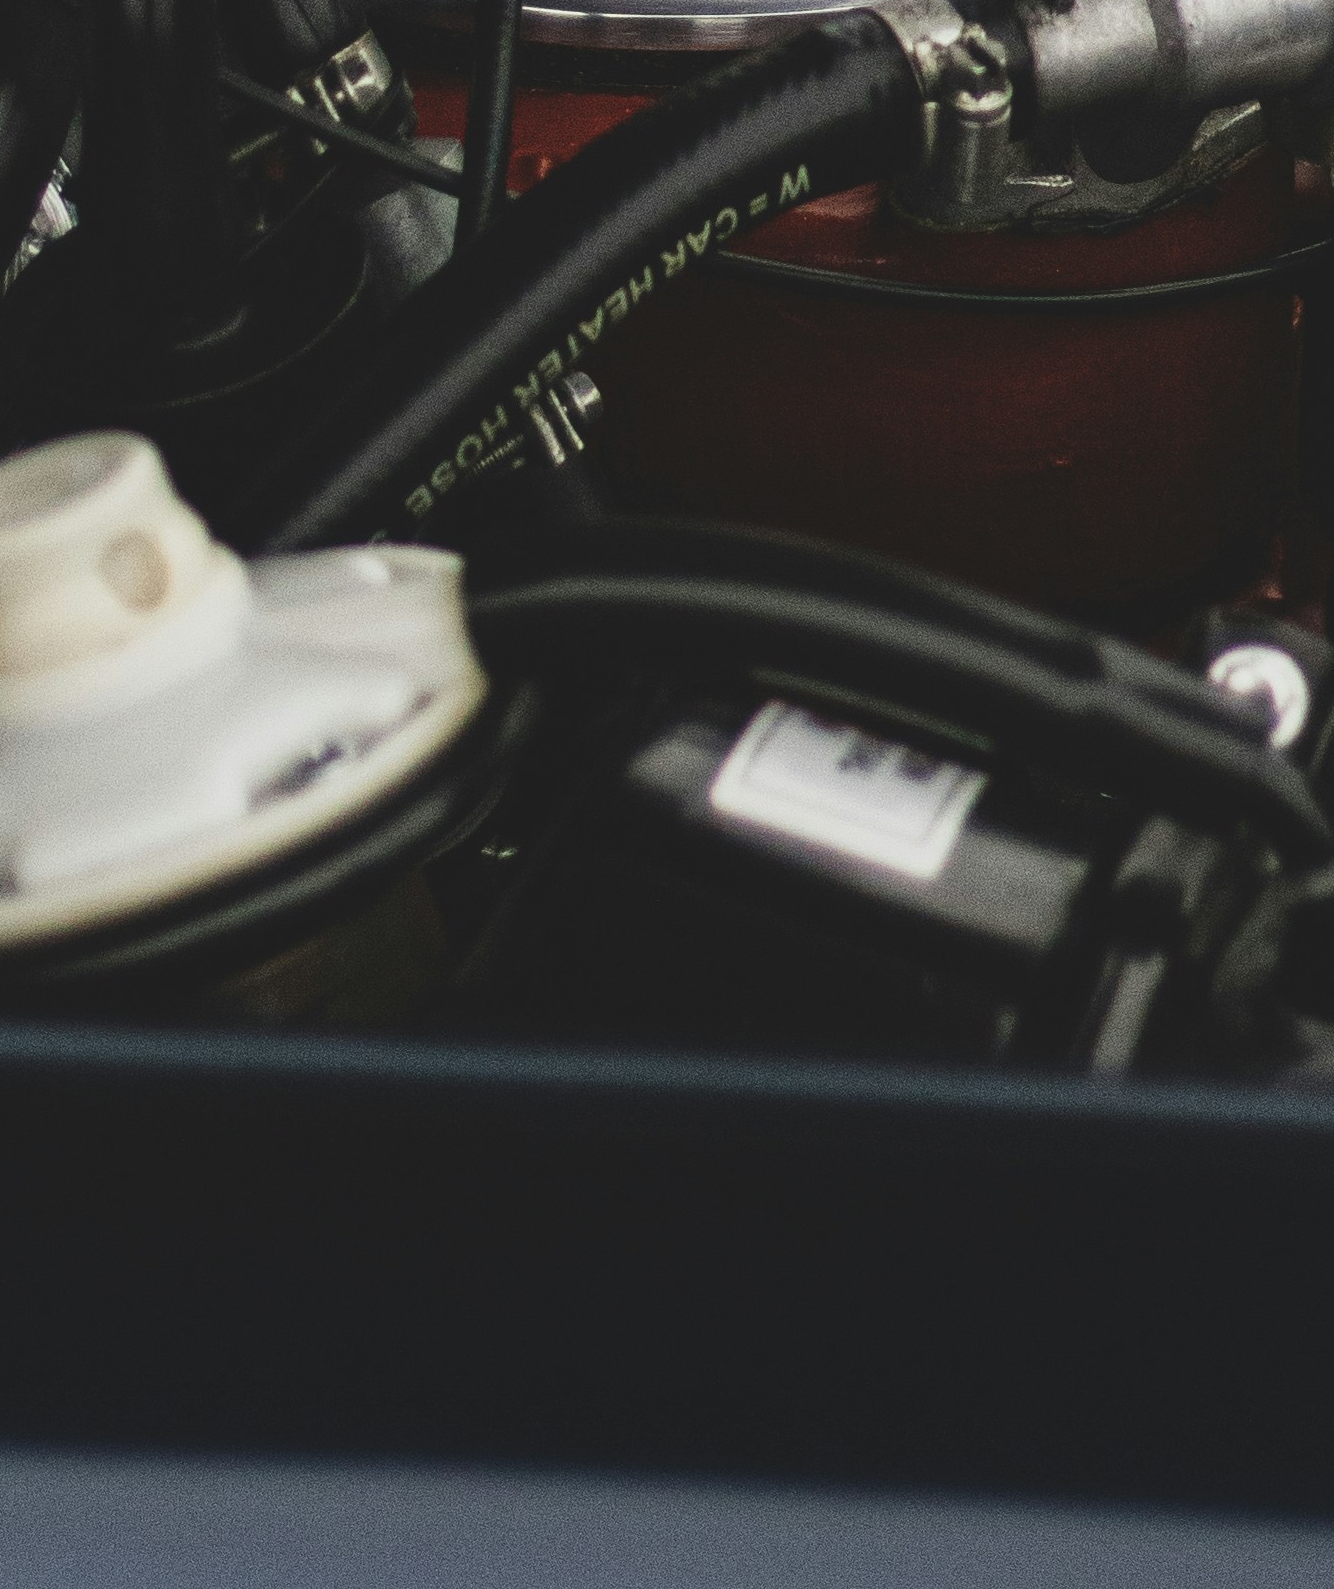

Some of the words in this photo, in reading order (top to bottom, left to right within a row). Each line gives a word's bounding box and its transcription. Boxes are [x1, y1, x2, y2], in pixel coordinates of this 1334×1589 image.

[661, 207, 738, 278] CAR
[513, 265, 654, 410] HEATER
[405, 405, 508, 516] HOSE
